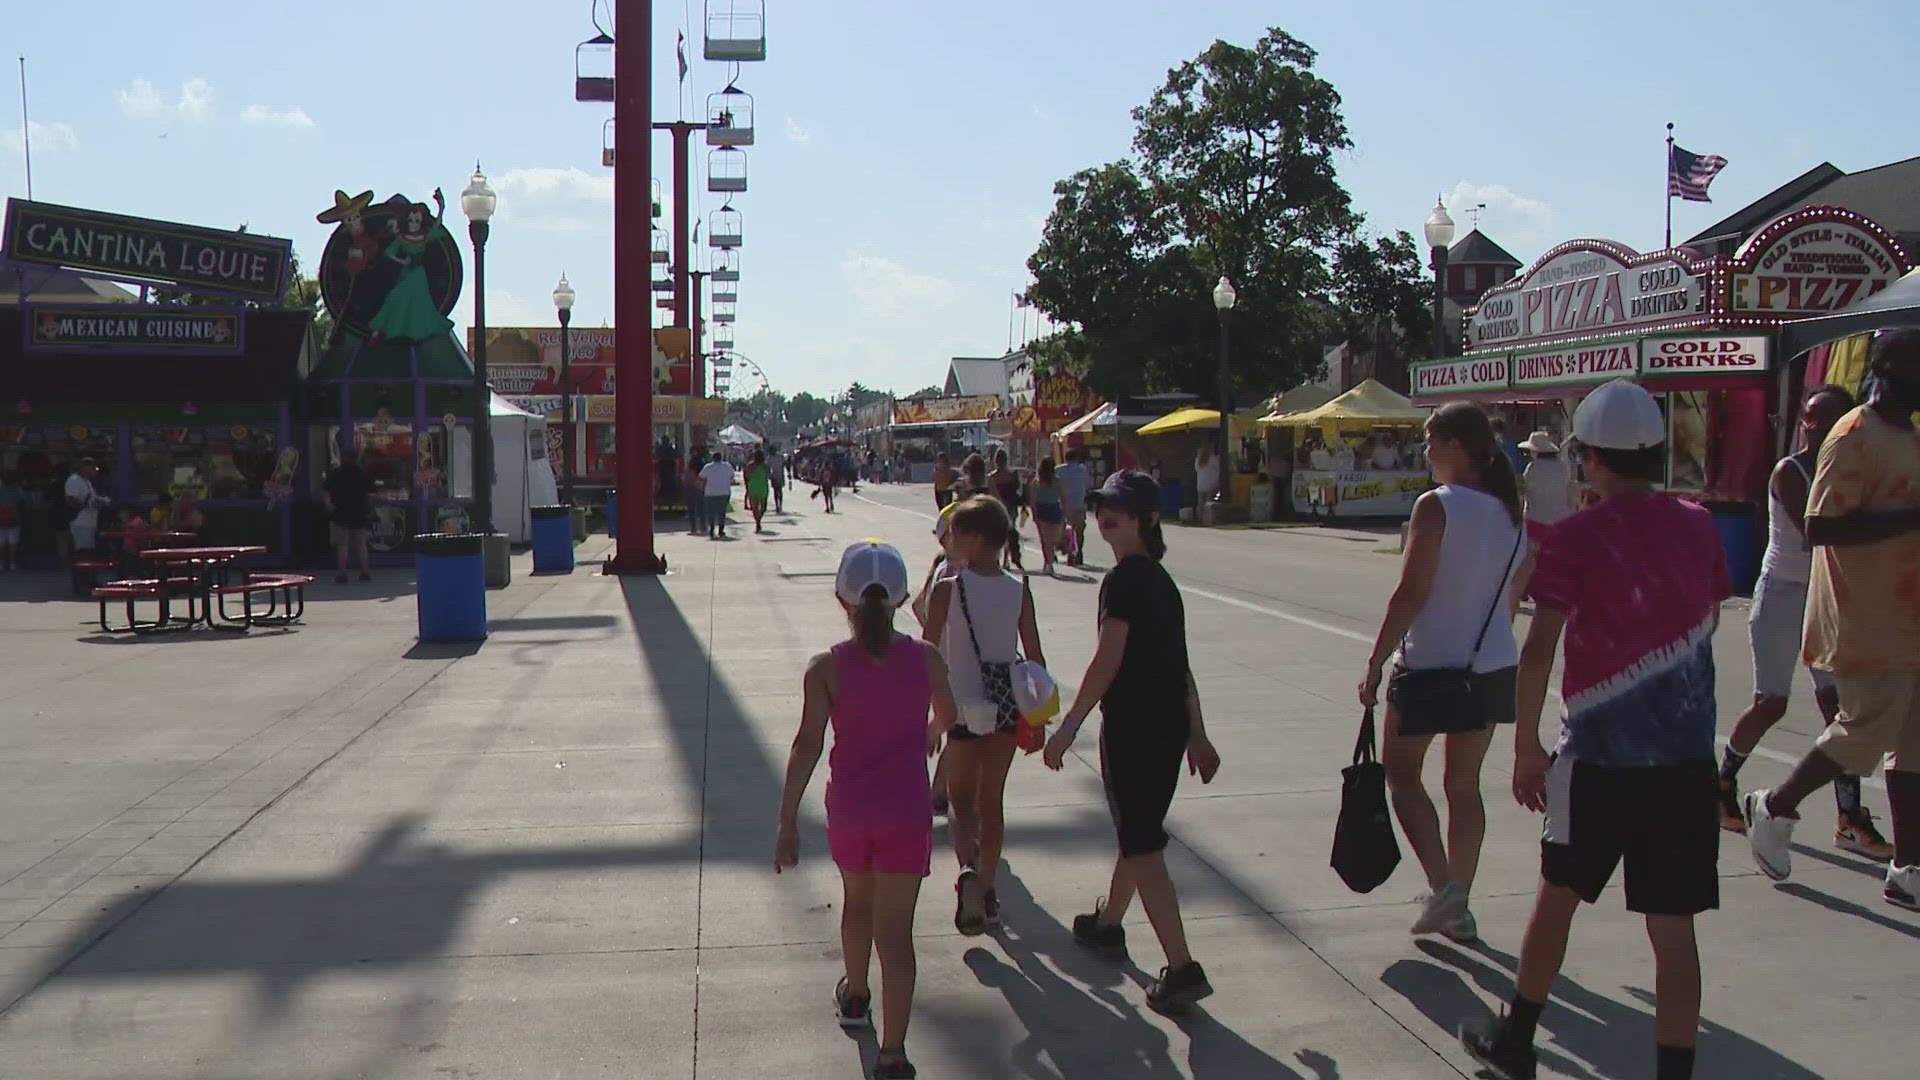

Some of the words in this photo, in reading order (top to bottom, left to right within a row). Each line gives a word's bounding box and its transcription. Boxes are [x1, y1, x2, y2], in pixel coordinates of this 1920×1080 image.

[27, 223, 167, 269] CANTINA
[180, 243, 267, 282] LOUIE
[1762, 244, 1789, 270] OLD
[1789, 229, 1832, 248] STYLE
[1845, 233, 1892, 274] ITALIAN
[1790, 253, 1865, 264] TRADITIONAL
[1639, 266, 1681, 293] COLD
[1484, 299, 1513, 320] COLD
[1521, 272, 1627, 336] PIZZA
[1630, 289, 1688, 319] DRINKS
[58, 318, 138, 338] MEXICAN
[146, 319, 213, 339] CUISINE
[1478, 318, 1519, 341] DRINKS
[1649, 353, 1757, 369] DRINKS
[1660, 341, 1742, 354] COLD
[1419, 368, 1457, 389] PIZZA
[1471, 361, 1505, 384] COLD
[1518, 353, 1564, 380] DRINKS
[1578, 346, 1634, 374] PIZZA
